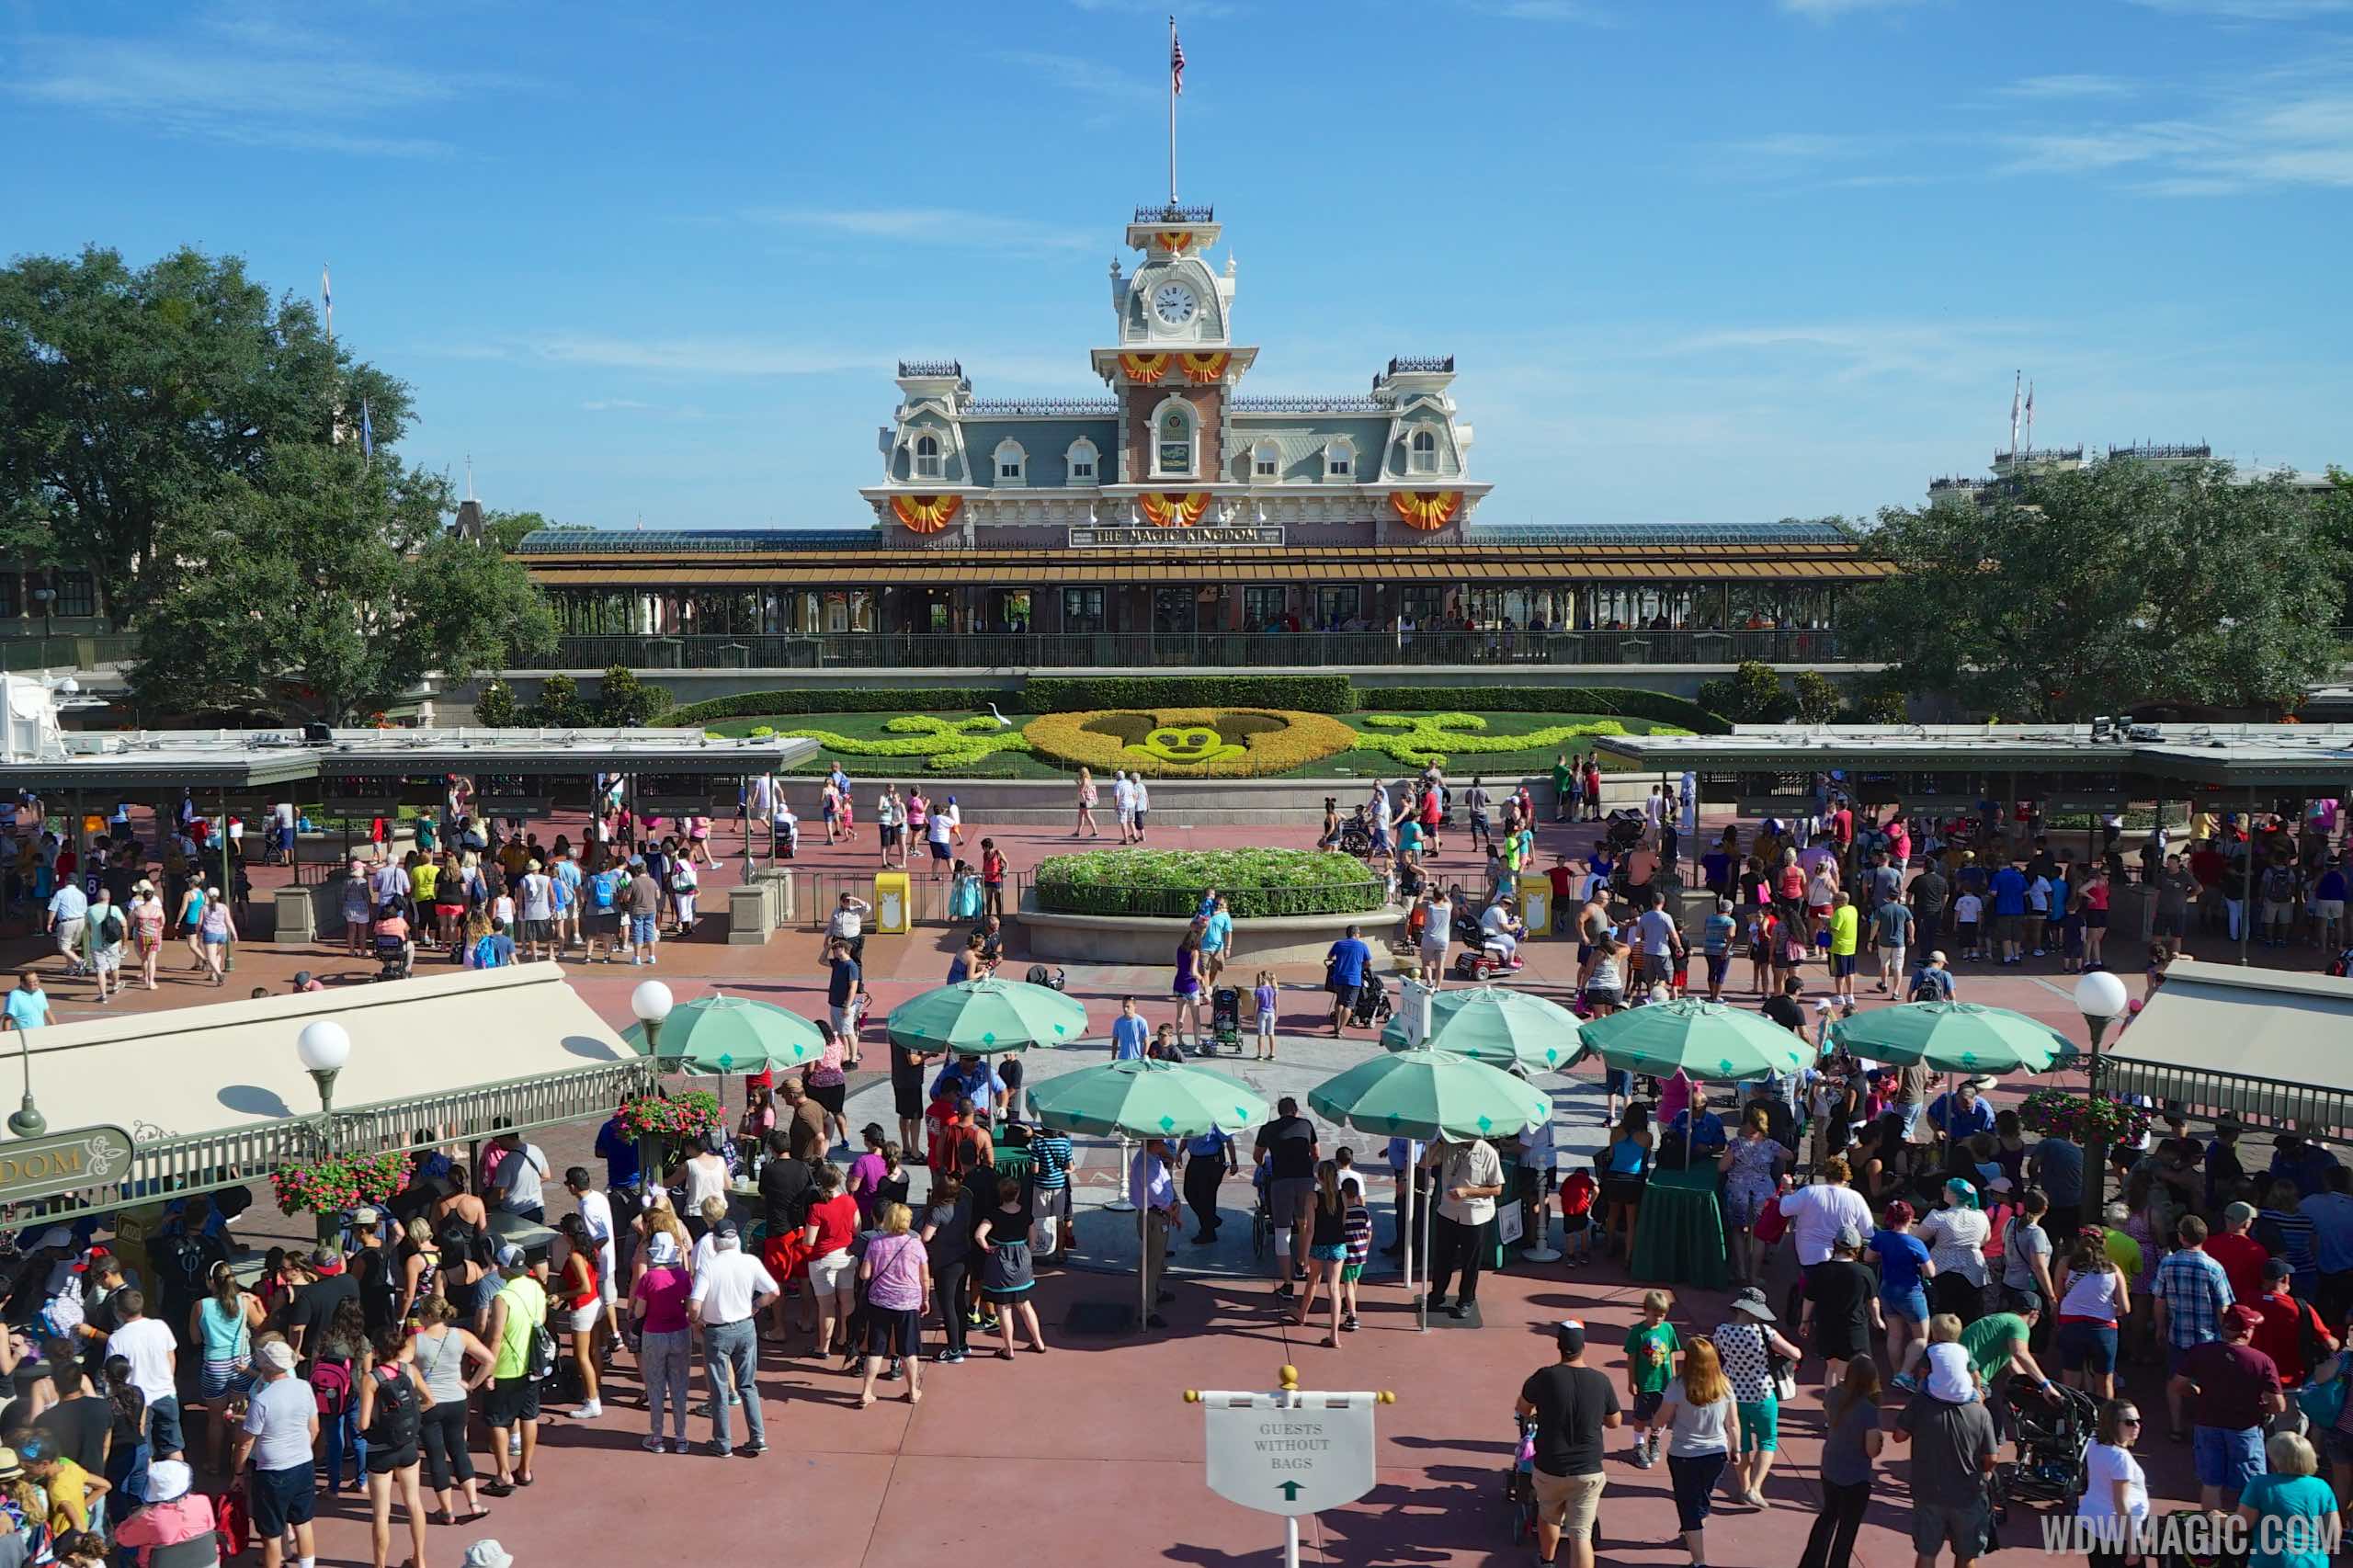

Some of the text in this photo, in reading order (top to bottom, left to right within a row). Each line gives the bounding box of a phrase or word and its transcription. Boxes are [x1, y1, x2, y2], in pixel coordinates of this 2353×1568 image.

[1096, 530, 1122, 541] THE
[1130, 529, 1179, 541] MAGIC
[1187, 528, 1258, 540] KINGDOM
[0, 1147, 83, 1184] DOM
[1259, 1424, 1324, 1435] GUESTS
[1254, 1439, 1331, 1452] WITHOUT
[1271, 1458, 1313, 1470] BAGS
